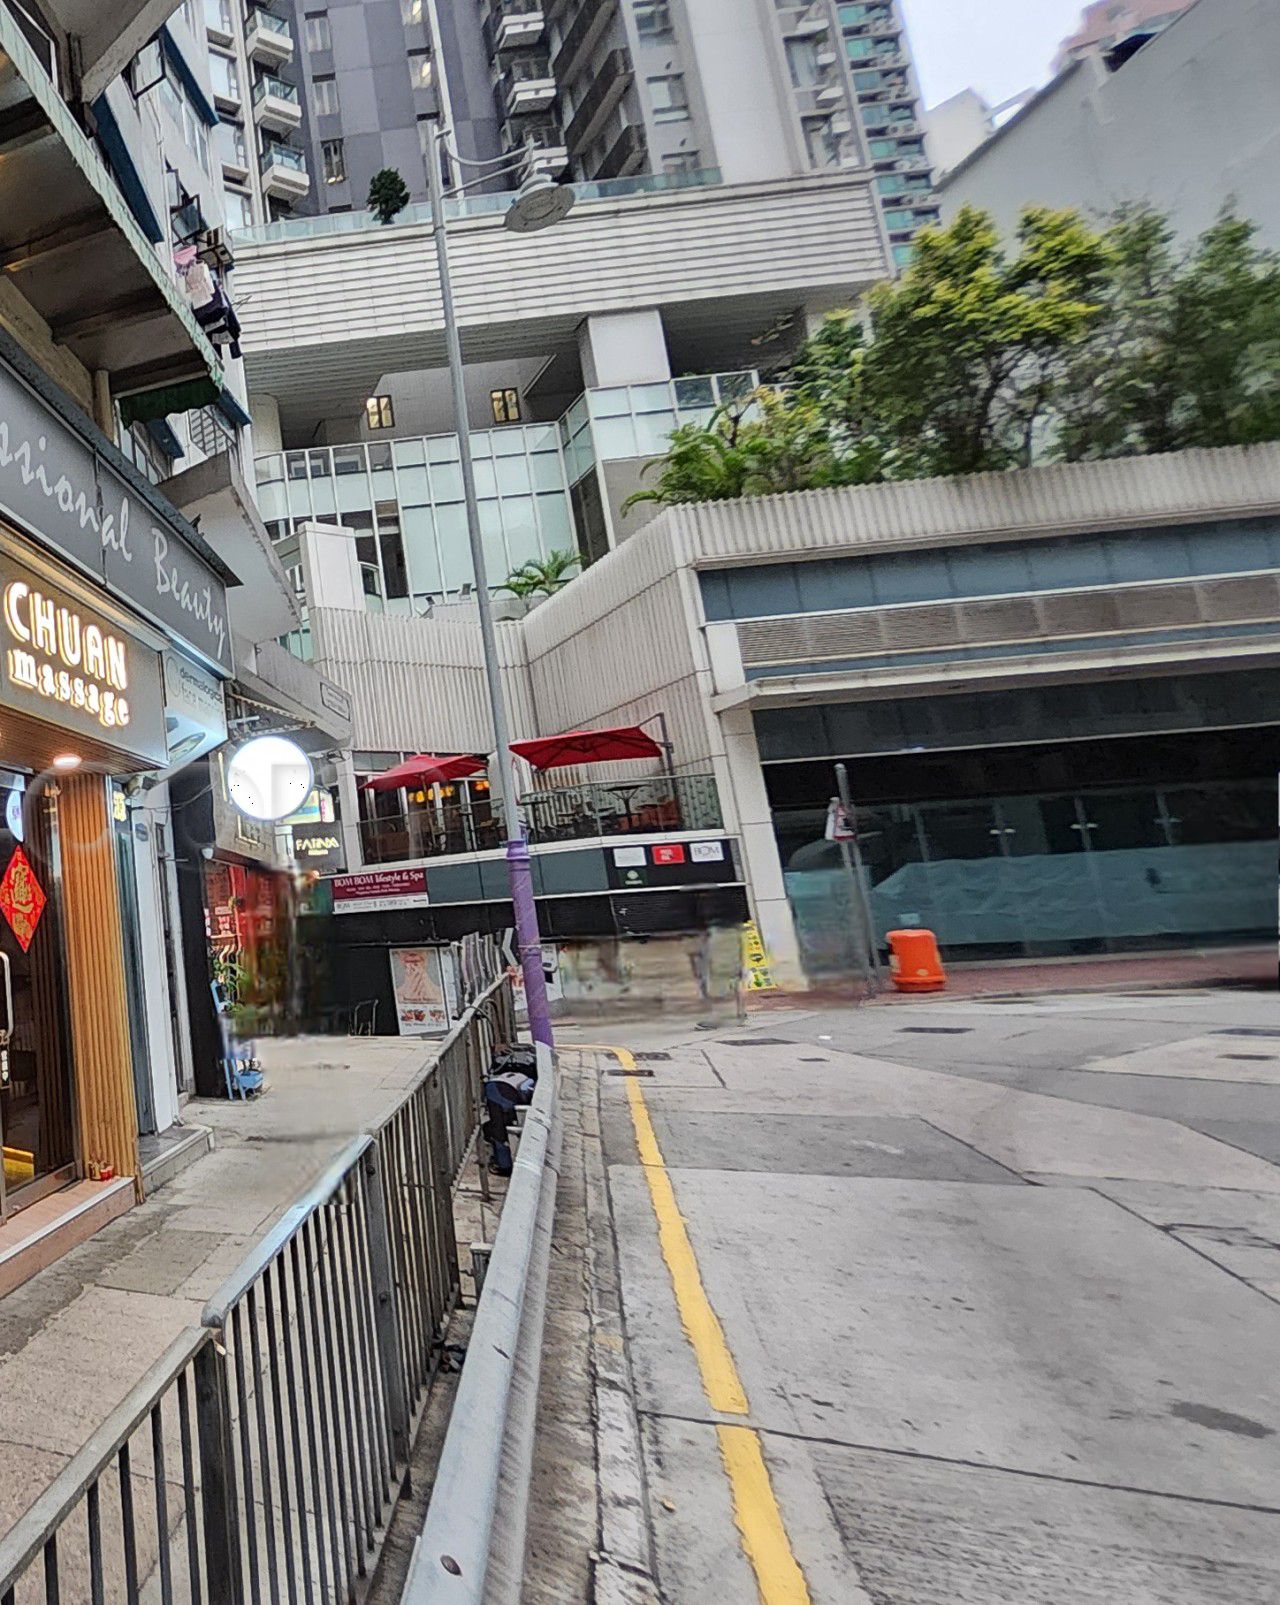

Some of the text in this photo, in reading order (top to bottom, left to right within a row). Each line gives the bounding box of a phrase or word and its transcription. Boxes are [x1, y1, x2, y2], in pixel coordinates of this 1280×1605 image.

[4, 582, 127, 691] CHUAN
[153, 527, 226, 660] Beauty
[7, 648, 130, 727] massage
